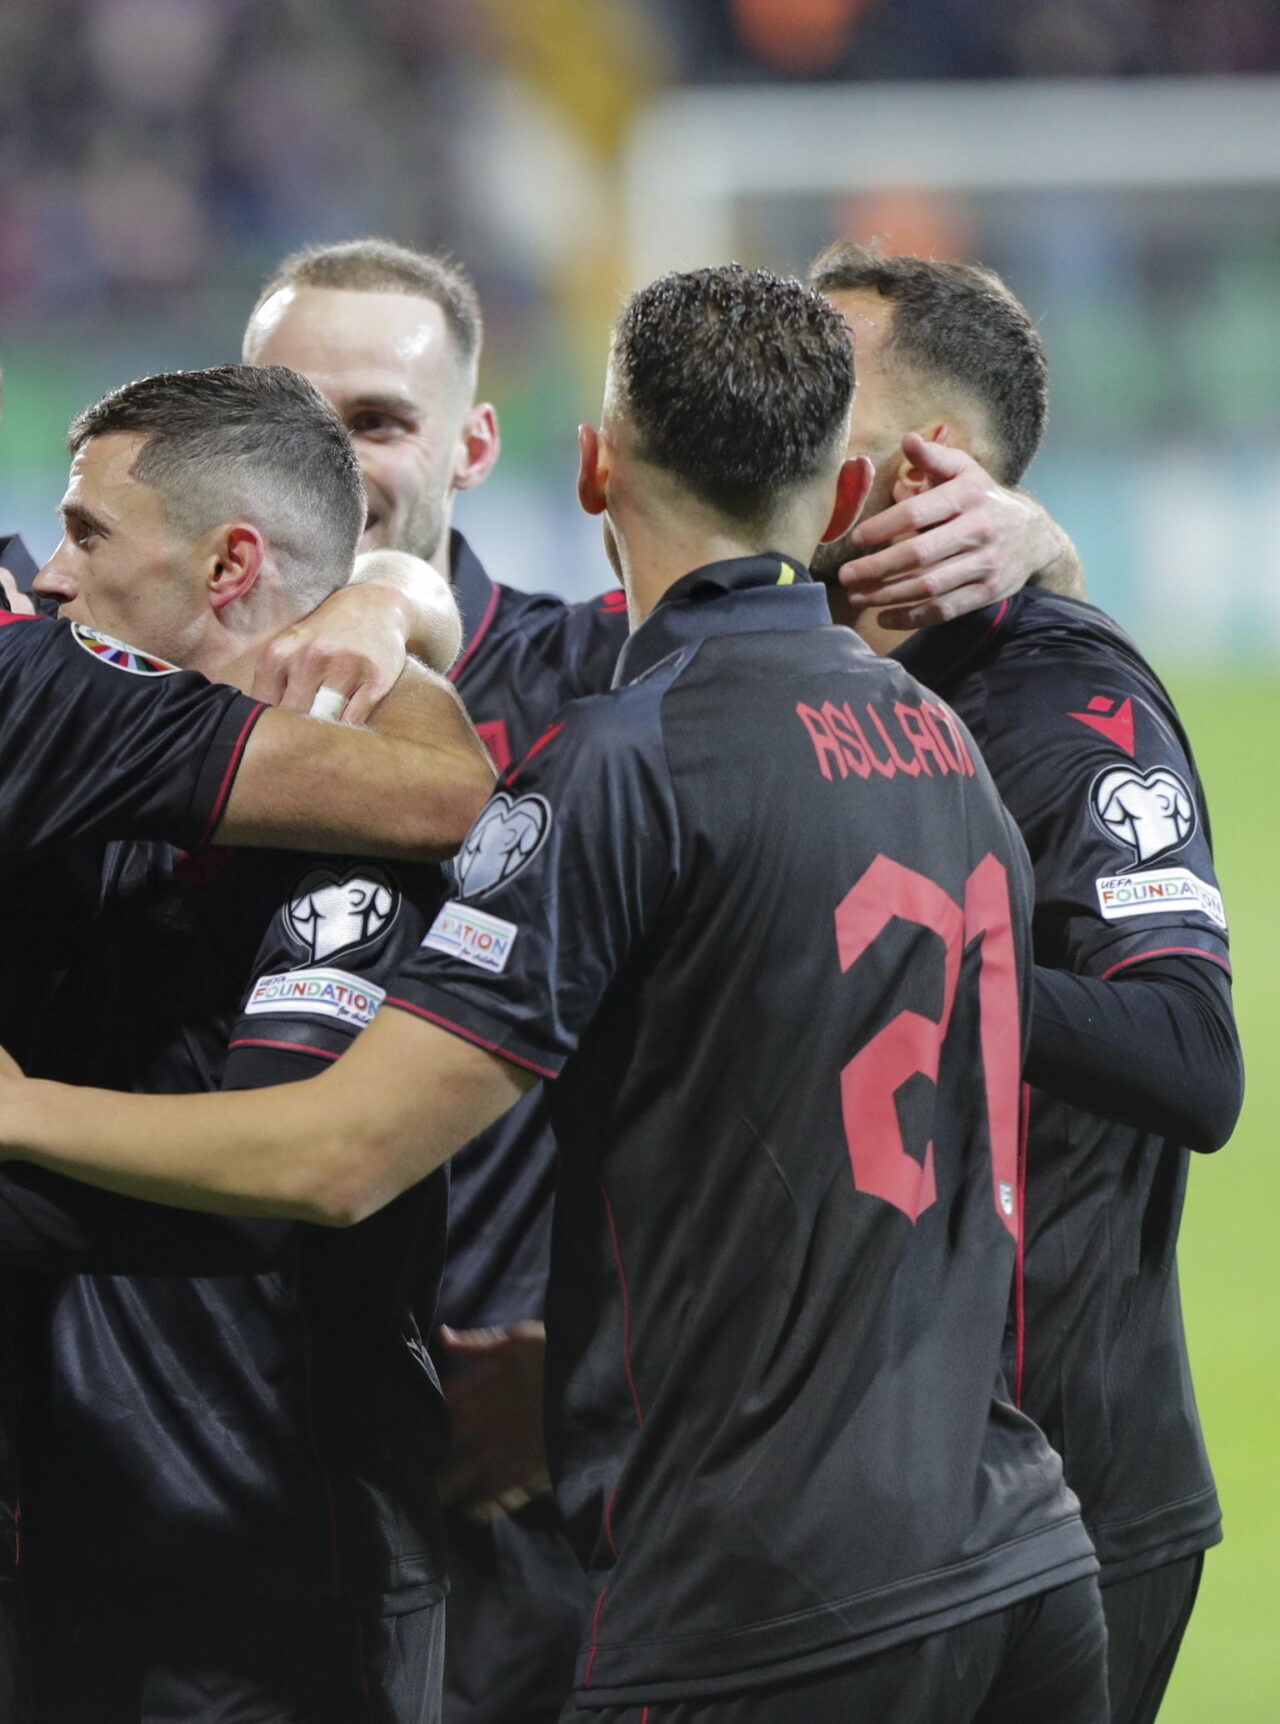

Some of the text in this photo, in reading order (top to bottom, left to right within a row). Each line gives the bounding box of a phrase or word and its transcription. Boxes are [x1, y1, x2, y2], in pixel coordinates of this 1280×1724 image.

[1100, 877, 1132, 889] UEFA
[433, 918, 508, 957] DATION
[834, 851, 1019, 1245] 21
